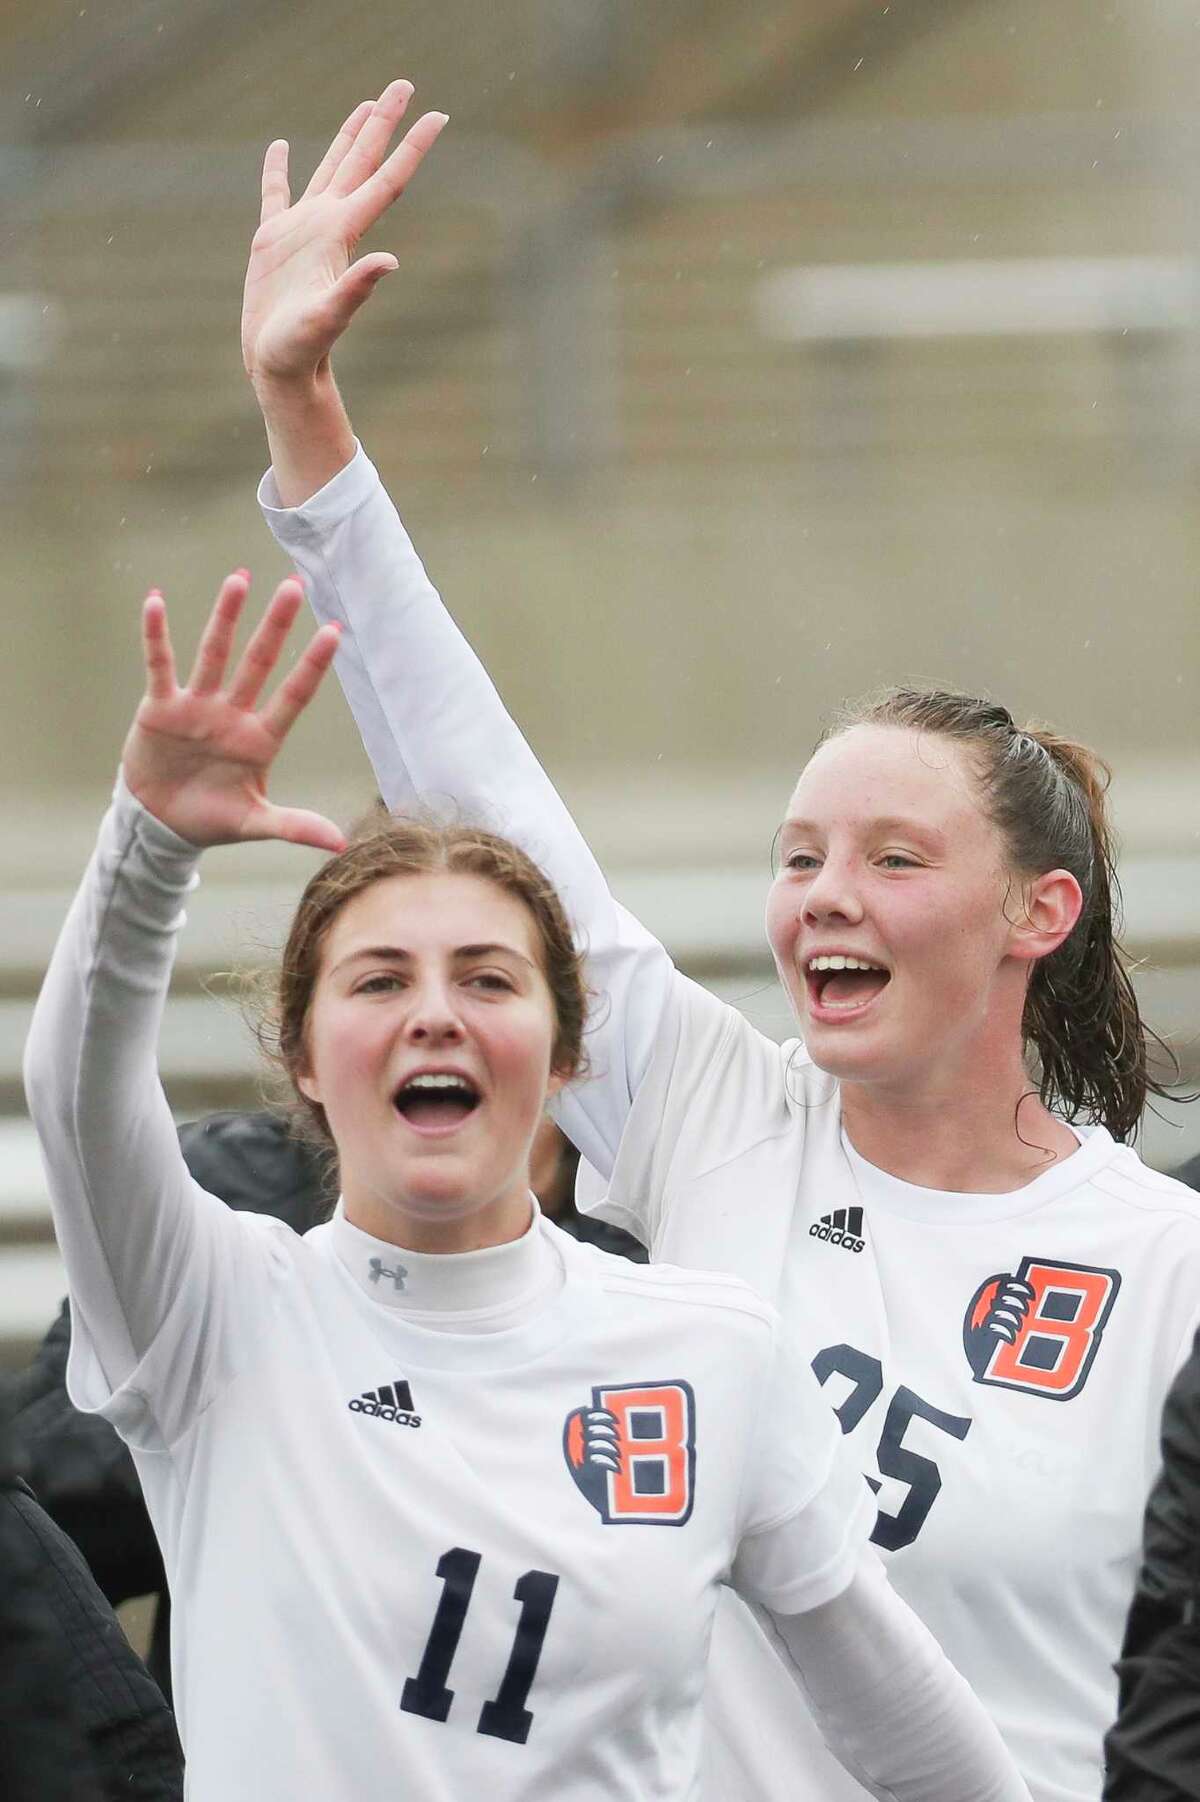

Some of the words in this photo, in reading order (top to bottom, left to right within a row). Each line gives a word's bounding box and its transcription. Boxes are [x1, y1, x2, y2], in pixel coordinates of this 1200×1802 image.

[809, 1223, 866, 1253] adidas
[980, 1257, 1122, 1402] B
[348, 1399, 422, 1428] adidas
[594, 1379, 697, 1527] B
[400, 1546, 560, 1745] 11
